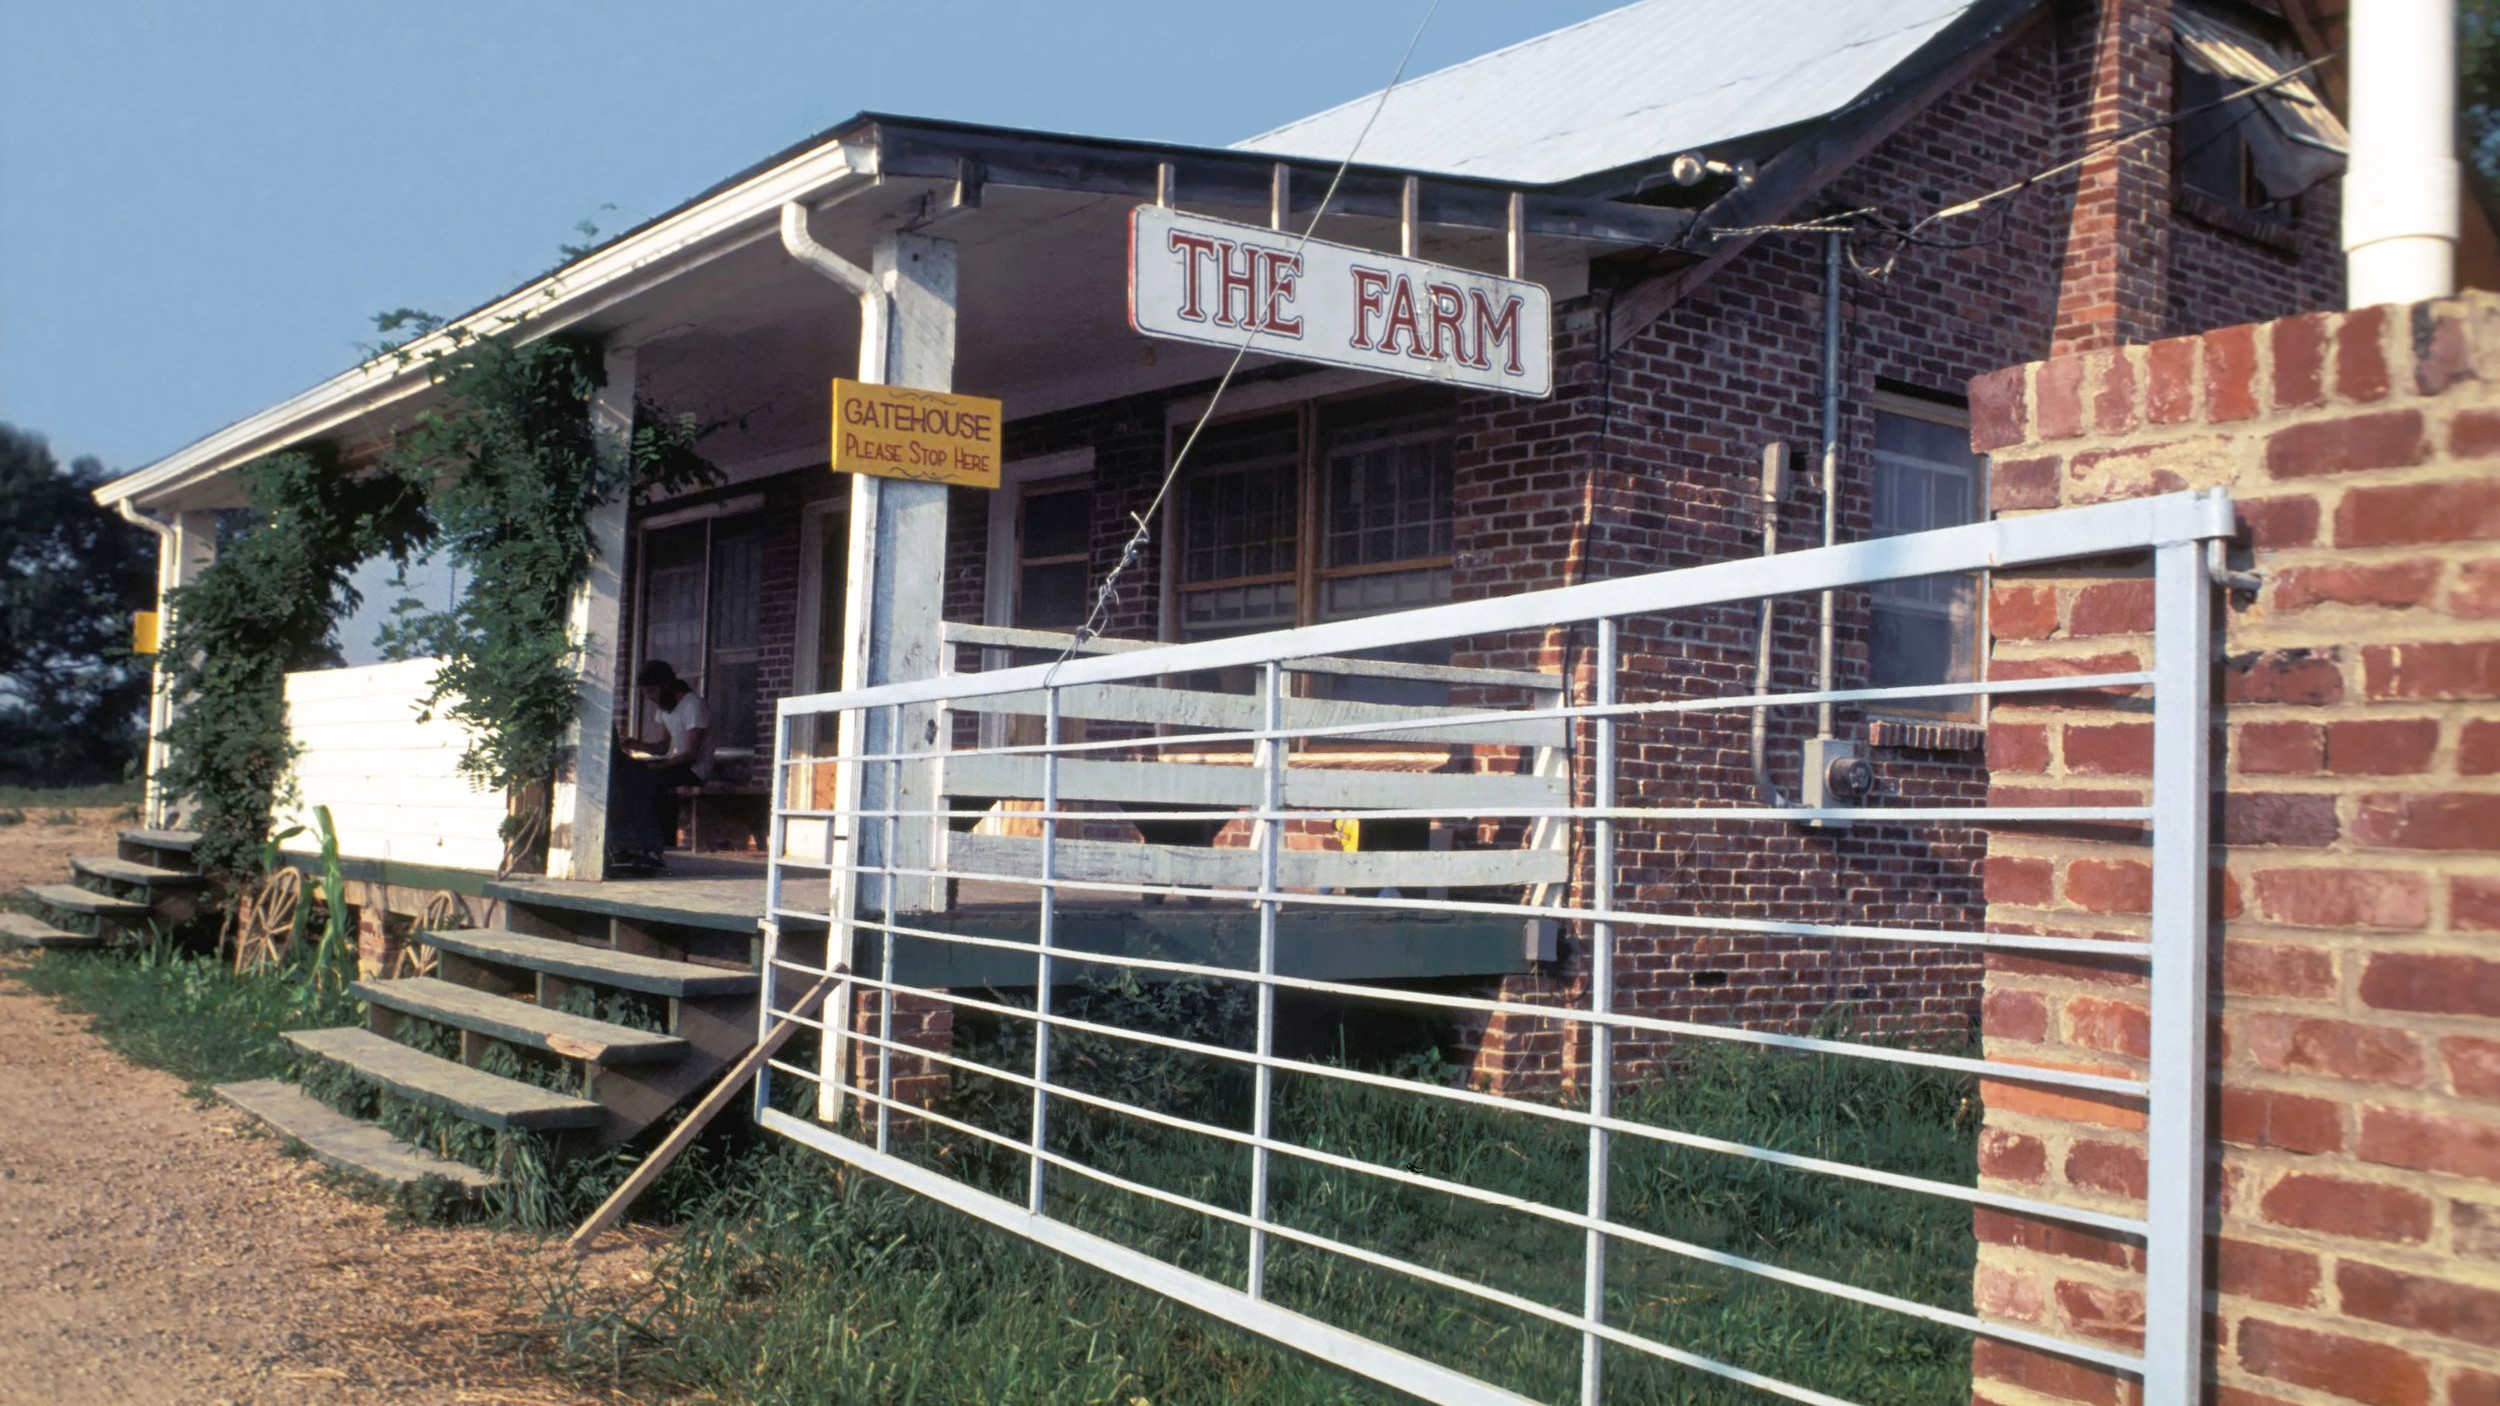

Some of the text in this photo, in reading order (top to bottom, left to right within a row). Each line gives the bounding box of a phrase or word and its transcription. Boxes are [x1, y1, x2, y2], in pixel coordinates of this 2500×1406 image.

[1168, 229, 1525, 376] THE FARM
[844, 398, 991, 442] GATEHOUSE
[845, 433, 990, 472] PLEASE STOP HERE
